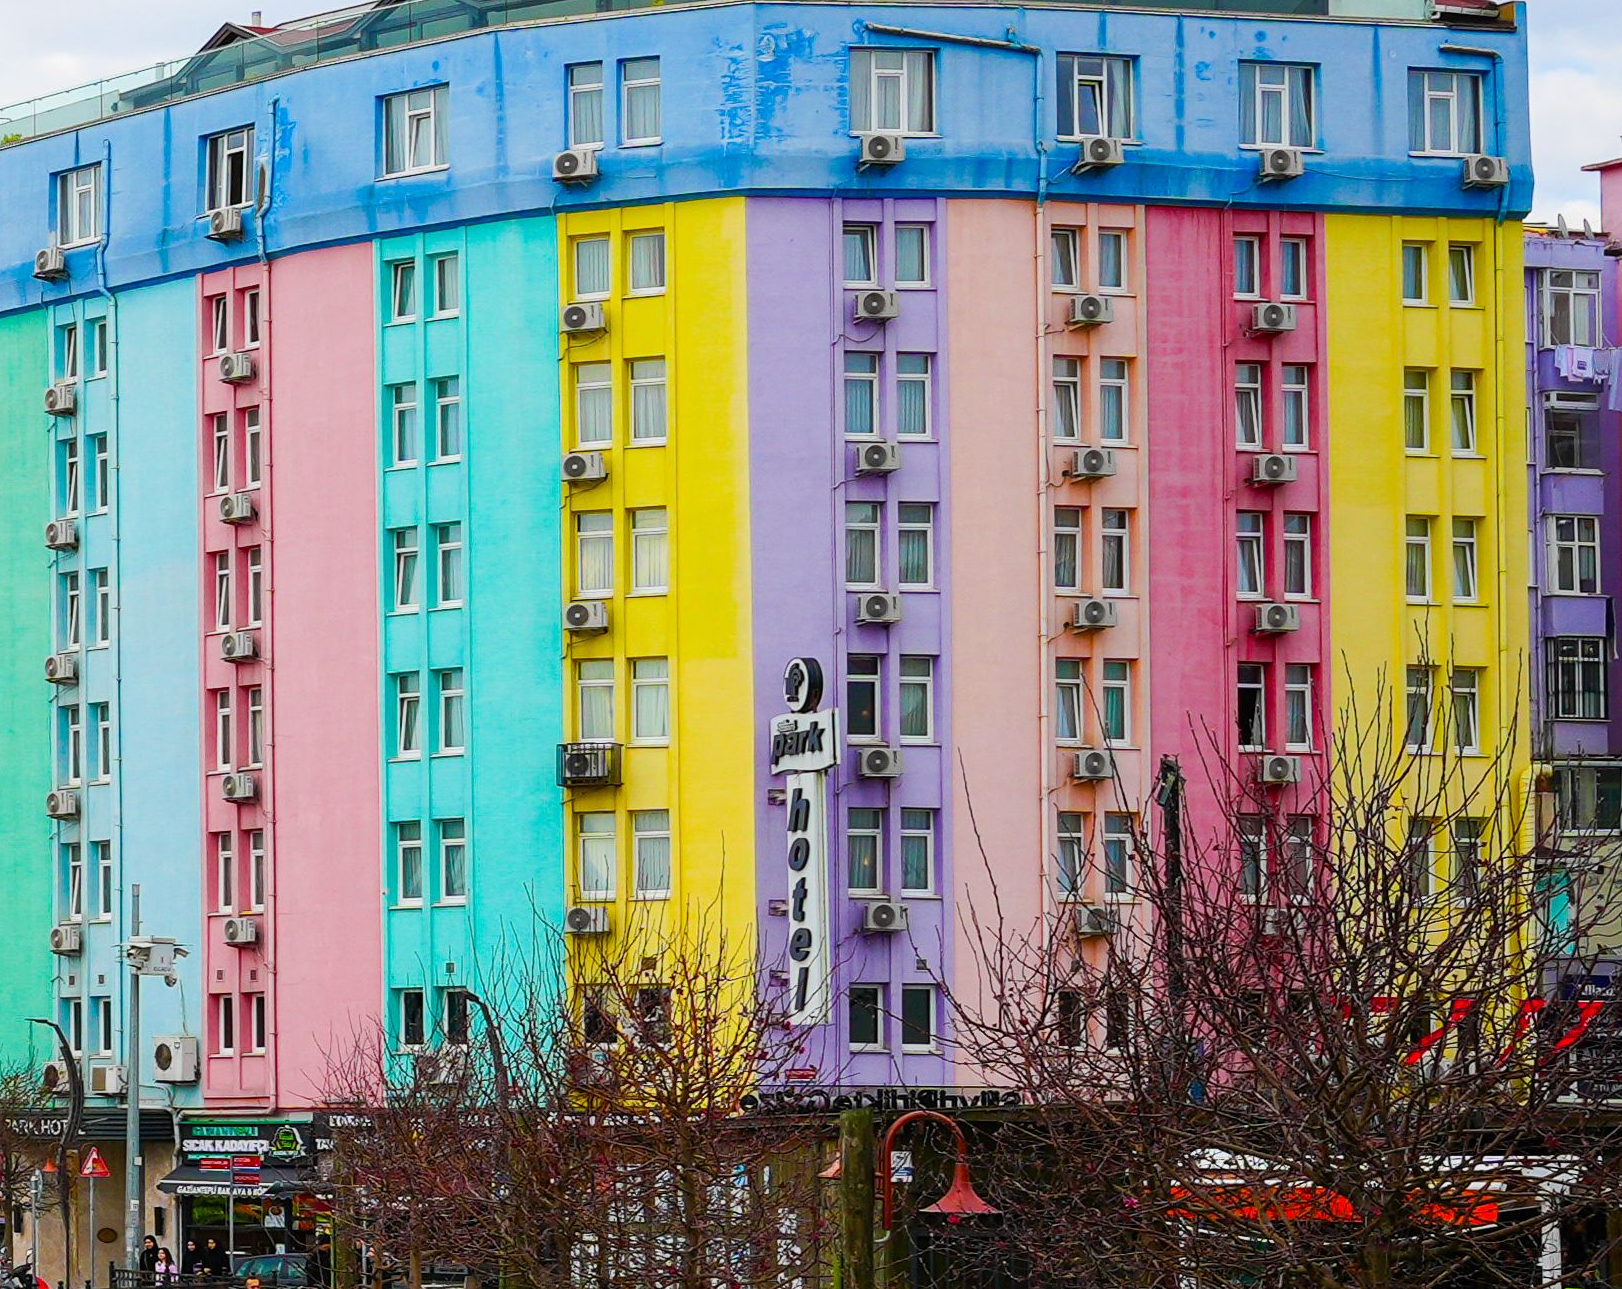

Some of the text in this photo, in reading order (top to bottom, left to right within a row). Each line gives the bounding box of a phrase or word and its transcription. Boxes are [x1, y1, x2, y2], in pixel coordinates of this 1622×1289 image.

[771, 721, 826, 766] park
[788, 787, 810, 1011] hotel
[40, 1118, 86, 1135] HOTL
